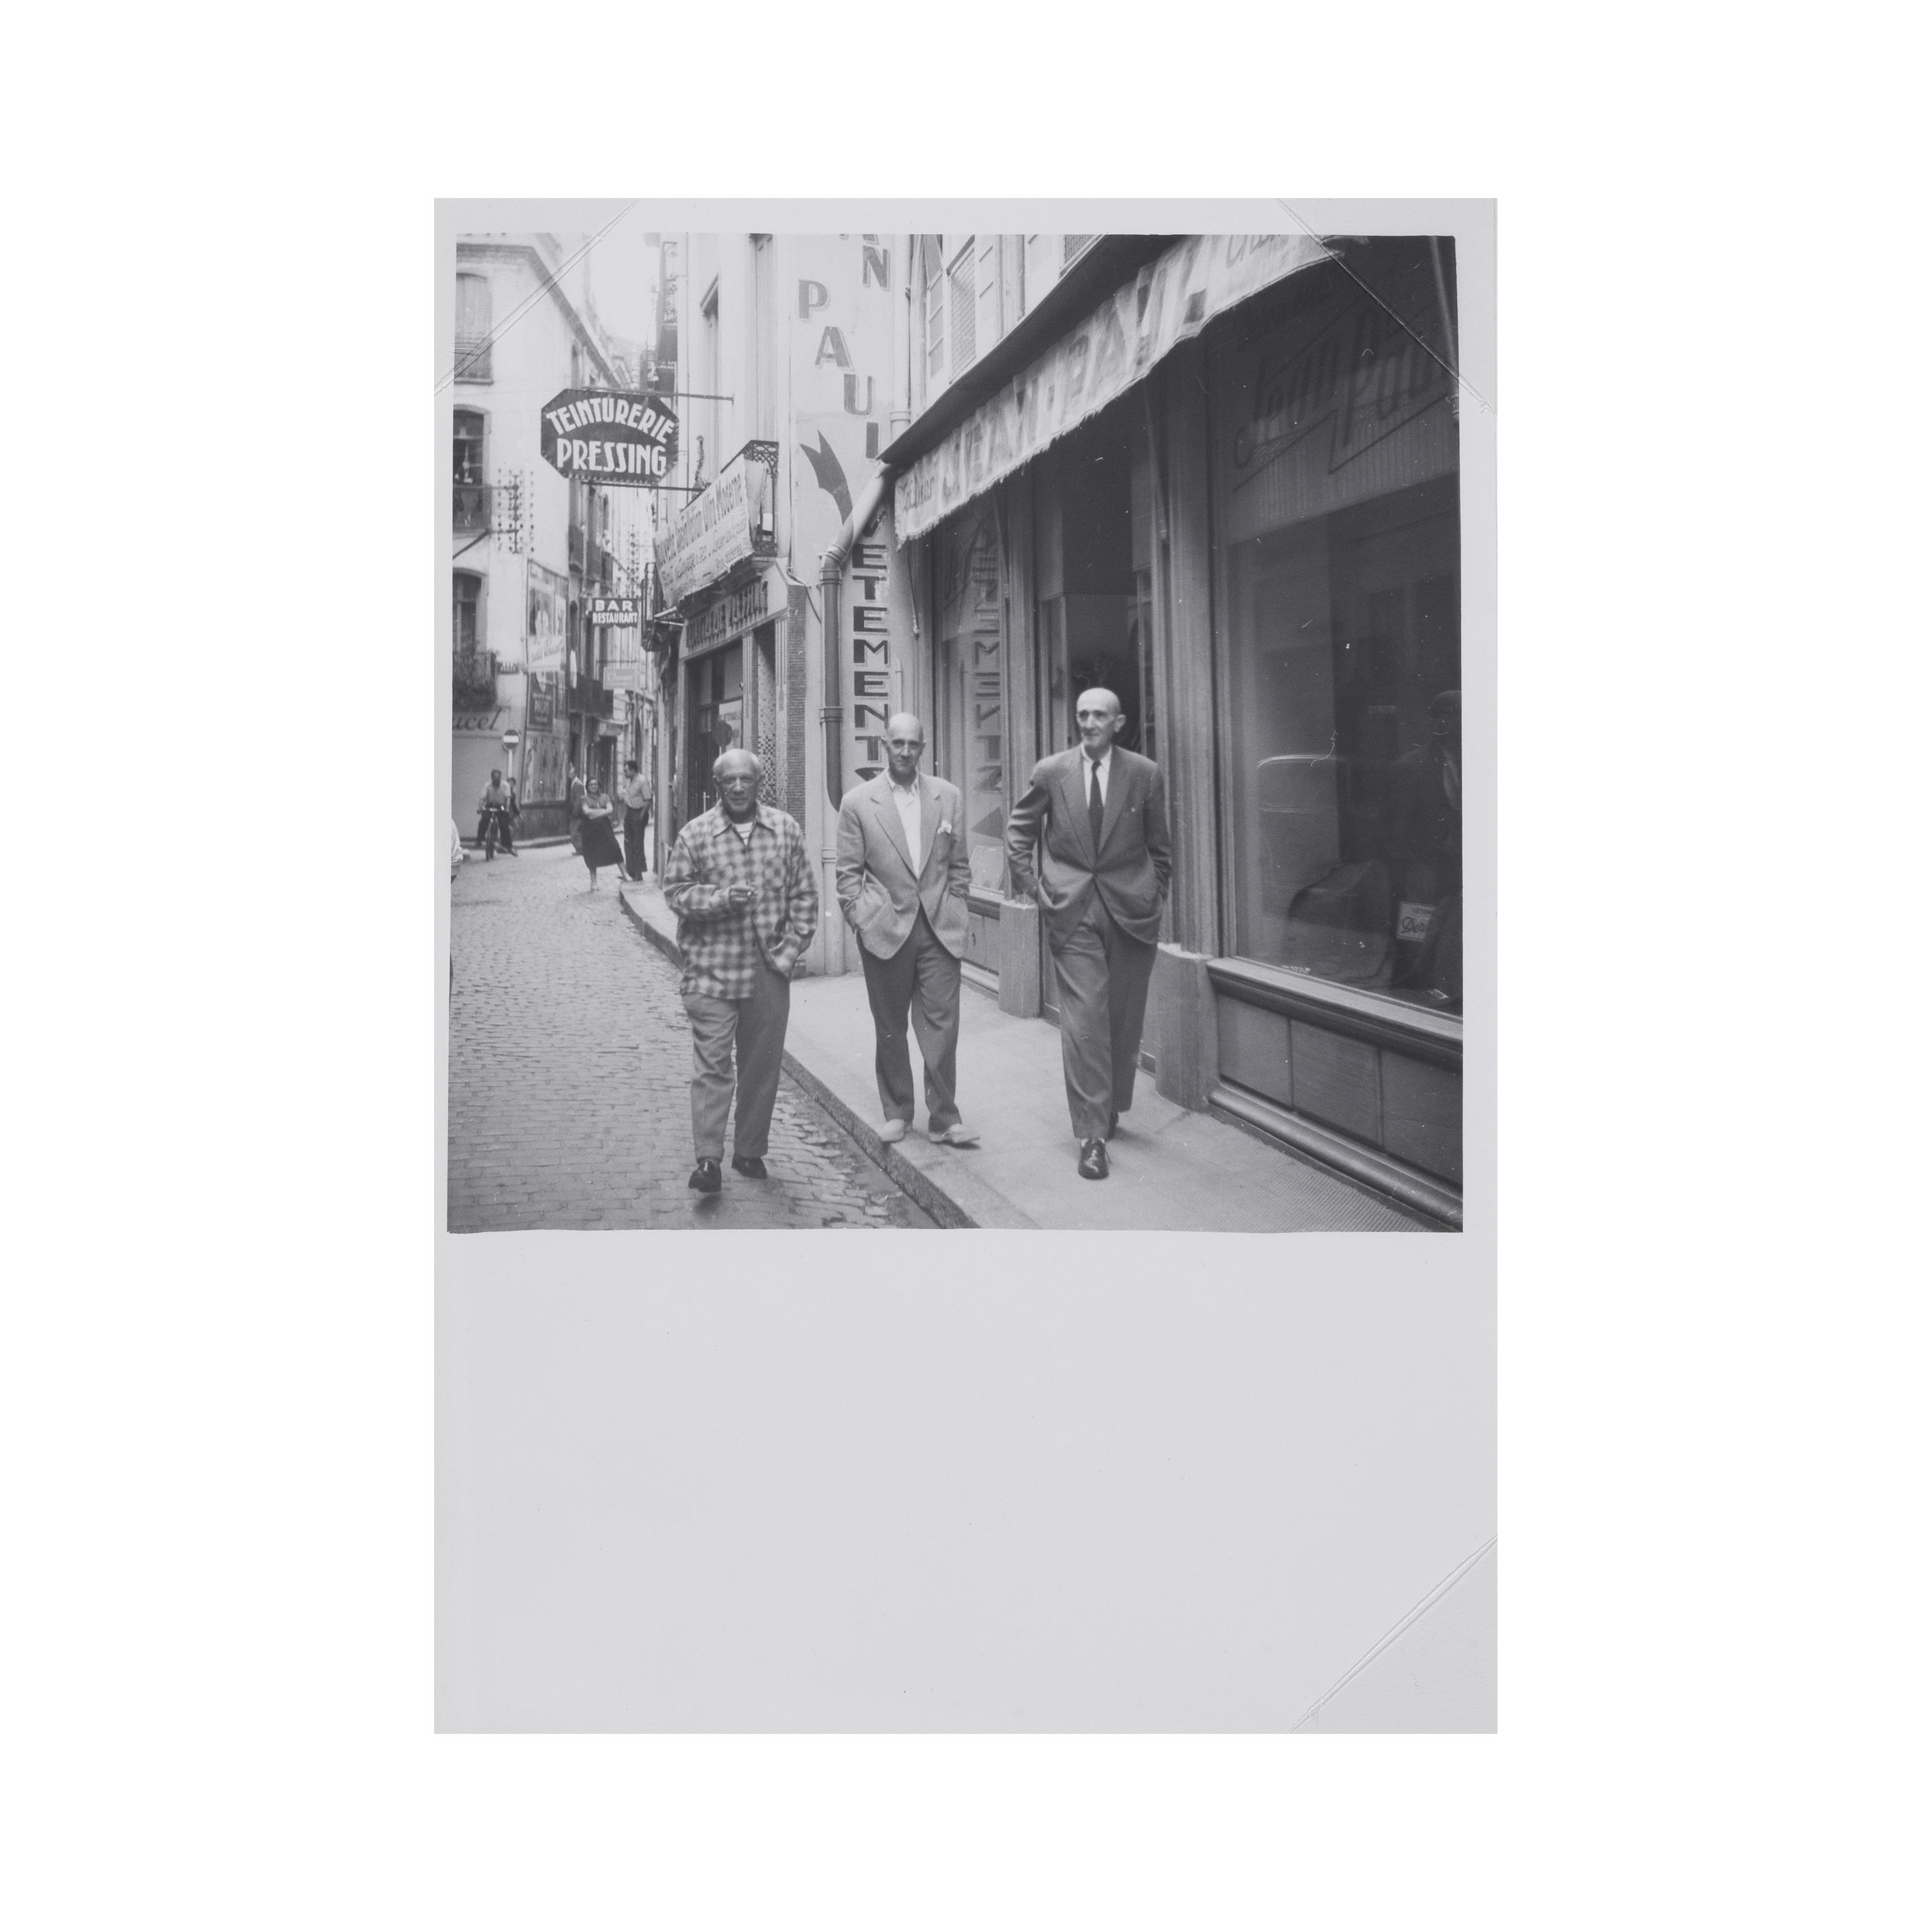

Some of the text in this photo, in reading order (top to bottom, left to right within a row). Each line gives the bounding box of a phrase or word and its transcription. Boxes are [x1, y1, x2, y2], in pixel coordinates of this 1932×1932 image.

[545, 397, 676, 444] TEINTURERIE
[557, 438, 667, 476] PRESSING
[715, 472, 743, 519] Moderne
[592, 612, 638, 624] RESTAURANT
[595, 599, 633, 612] BAR
